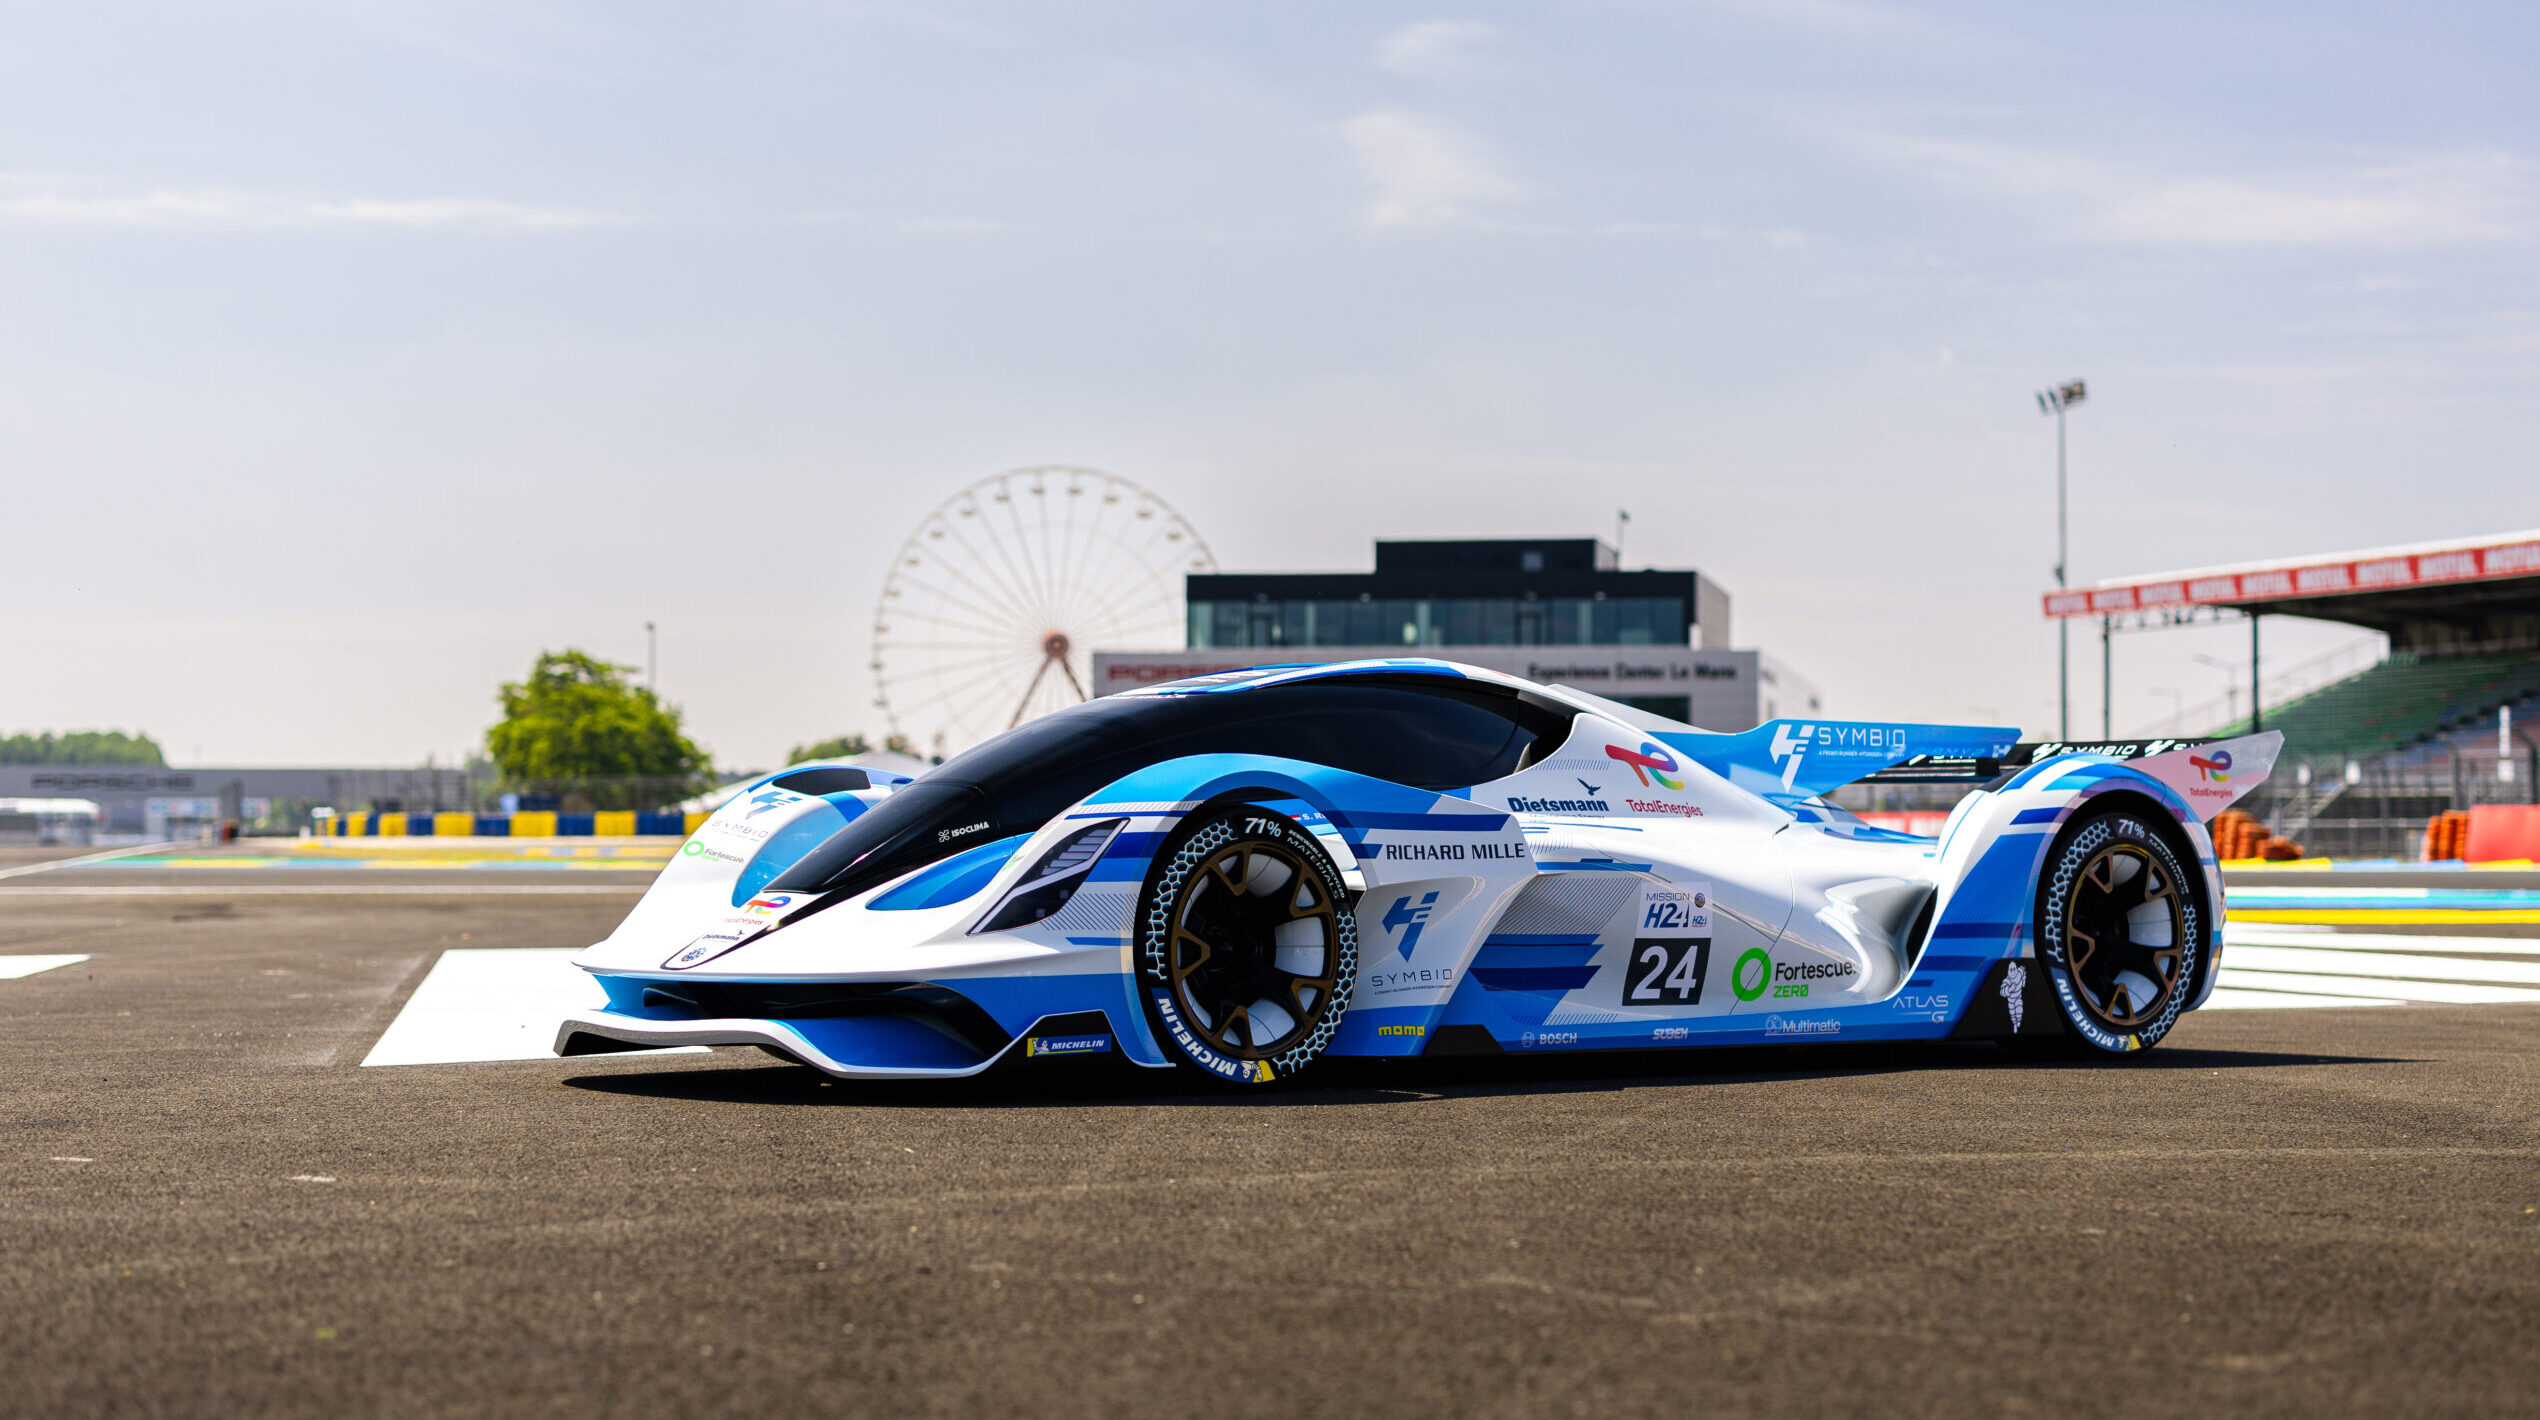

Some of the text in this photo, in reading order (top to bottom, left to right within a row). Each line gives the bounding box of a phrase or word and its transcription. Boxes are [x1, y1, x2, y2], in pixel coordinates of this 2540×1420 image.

[1528, 662, 1737, 680] Experience Center Le Mans
[1818, 727, 1906, 747] SYMBIO
[31, 773, 196, 791] PORSCHE
[2189, 787, 2233, 799] TotalEnergies
[1507, 797, 1610, 813] Dietsmann
[1626, 799, 1704, 818] TotalEnergies
[951, 821, 989, 837] ISOCLIMA
[1244, 817, 1282, 837] 71%
[2118, 819, 2145, 838] 71%
[1386, 843, 1525, 860] RICHARD MILLE
[1286, 837, 1340, 900] MATERIALS
[1646, 893, 1690, 901] MISSION
[1643, 903, 1690, 928] H24
[1372, 968, 1453, 987] SYMBIO
[1631, 945, 1698, 999] 24
[1893, 995, 1949, 1008] ATLAS
[2057, 978, 2115, 1047] MICHELIN
[1782, 1019, 1841, 1033] Multimatic
[1051, 1040, 1105, 1050] MICHELIN
[1158, 998, 1237, 1076] MICHELIN
[1539, 1033, 1577, 1044] BOSCH
